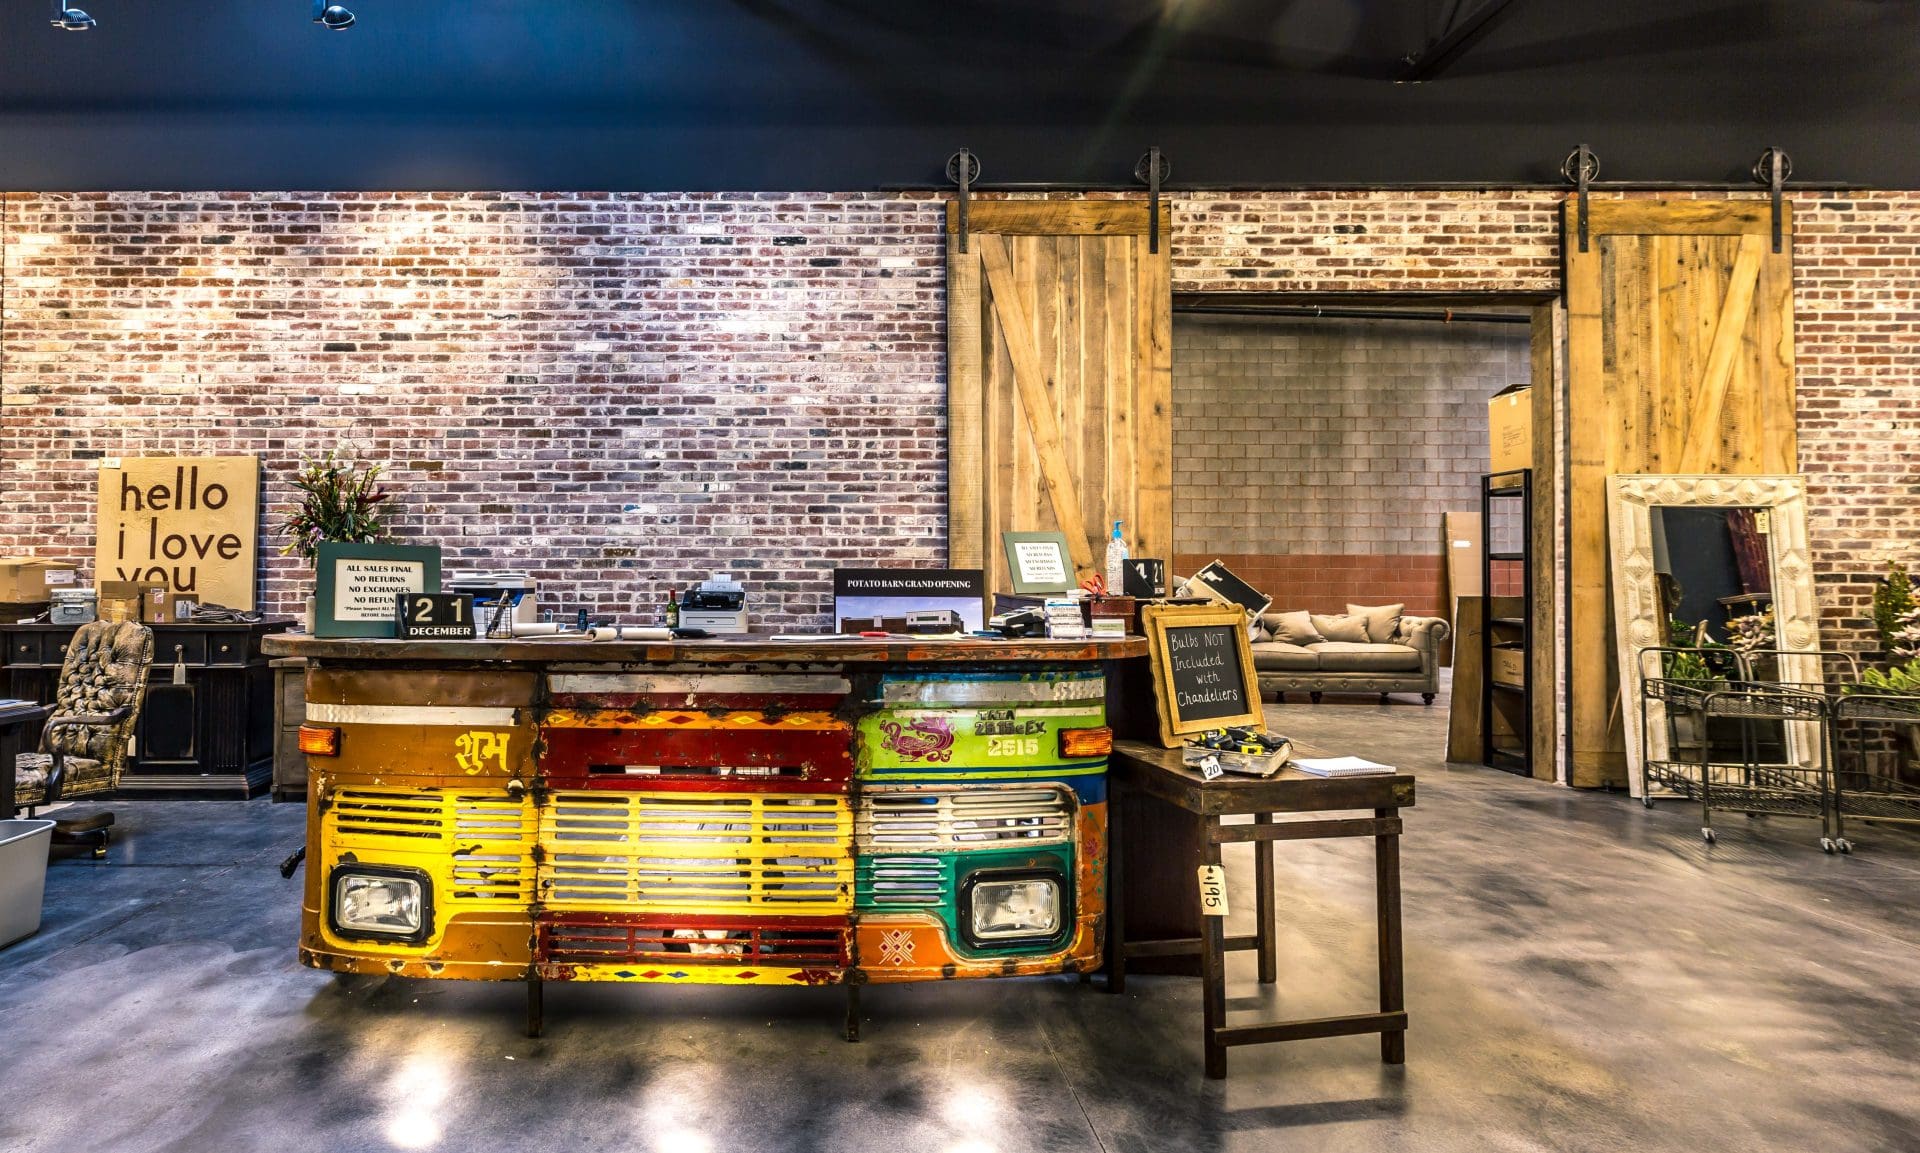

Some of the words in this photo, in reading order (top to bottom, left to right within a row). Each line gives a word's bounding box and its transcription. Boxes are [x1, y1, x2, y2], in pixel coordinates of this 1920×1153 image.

[120, 466, 229, 512] hello
[118, 523, 126, 560] i
[150, 517, 242, 560] love
[364, 565, 389, 573] SALES
[847, 579, 881, 588] POTATO
[881, 580, 905, 588] BARN
[905, 580, 935, 588] GRAND
[935, 580, 971, 589] OPENING
[368, 596, 395, 604] REFUN
[415, 598, 434, 622] 2
[451, 598, 463, 622] 1
[409, 626, 471, 636] DECEMBER
[1171, 633, 1199, 652] Bulbs
[1204, 632, 1225, 647] NOT
[1172, 651, 1225, 671] Included
[1195, 670, 1221, 685] with
[1177, 688, 1238, 707] Chandeliers
[978, 709, 1016, 720] TATA
